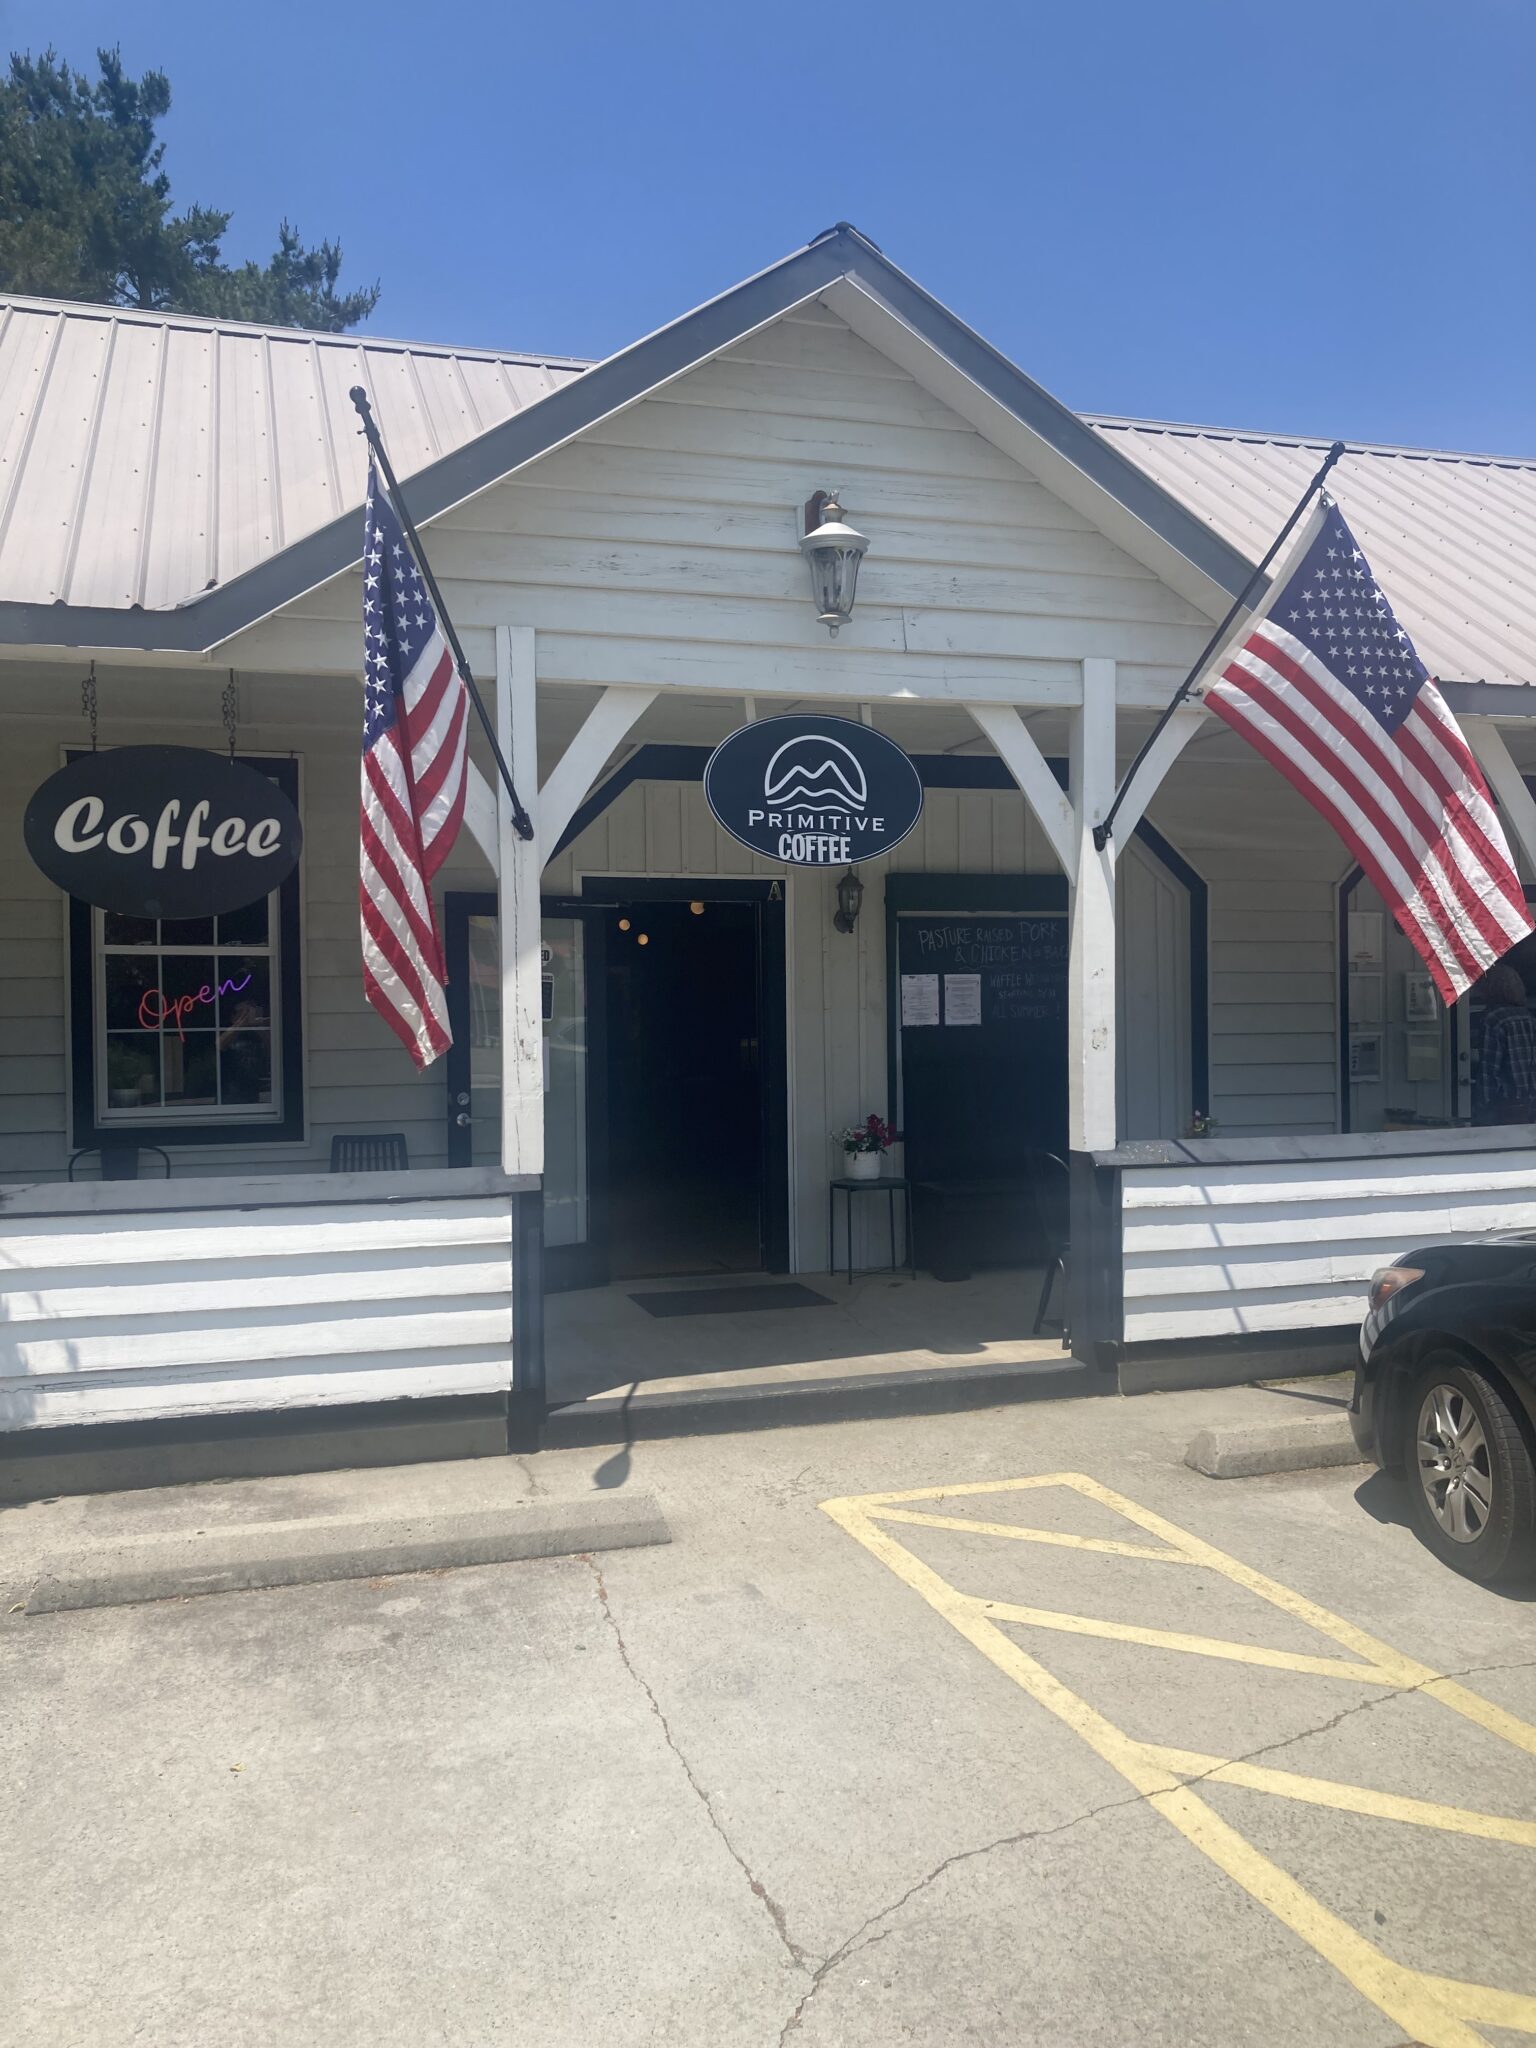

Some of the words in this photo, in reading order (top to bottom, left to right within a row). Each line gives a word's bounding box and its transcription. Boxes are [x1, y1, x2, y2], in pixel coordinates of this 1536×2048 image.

[54, 796, 282, 870] Coffee
[748, 809, 885, 832] PRIMITIVE
[778, 833, 852, 863] COFFEE
[918, 926, 972, 955] PASTURE
[976, 927, 1014, 943] RAISED
[1018, 921, 1061, 942] PORK
[954, 947, 966, 963] &
[971, 944, 1033, 964] CHICKEN
[139, 974, 252, 1042] Open
